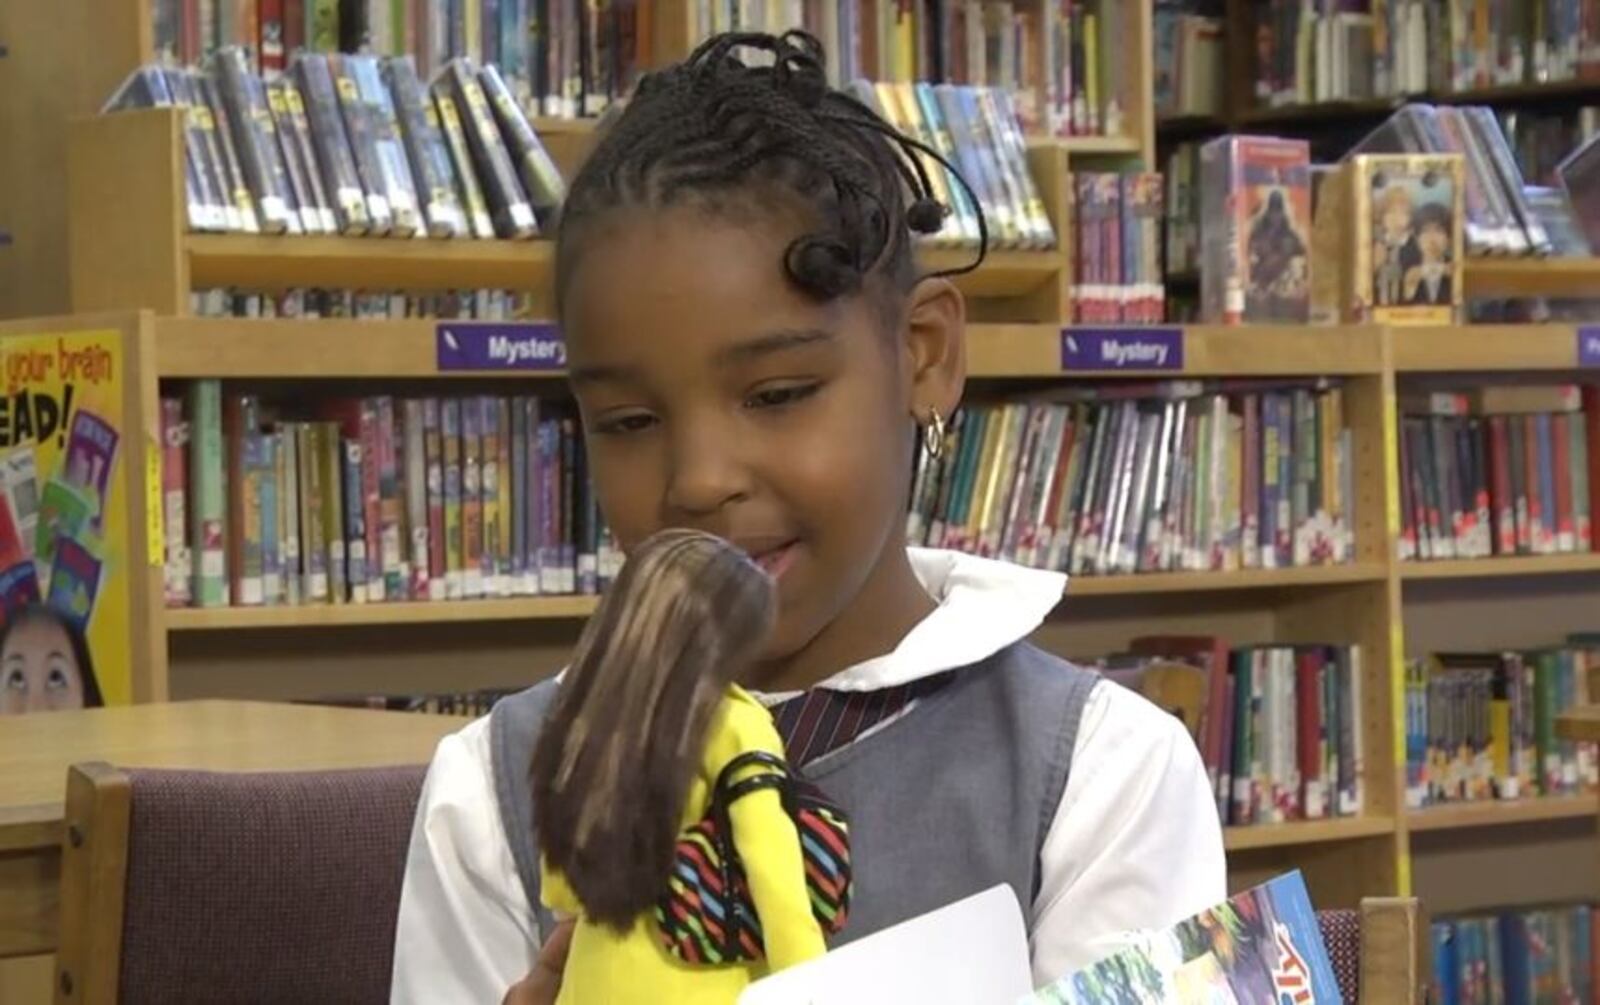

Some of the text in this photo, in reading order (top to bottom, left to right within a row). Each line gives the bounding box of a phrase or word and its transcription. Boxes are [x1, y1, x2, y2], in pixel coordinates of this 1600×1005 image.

[57, 337, 113, 384] brain
[488, 335, 567, 364] Mystery
[1101, 339, 1168, 366] Mystery
